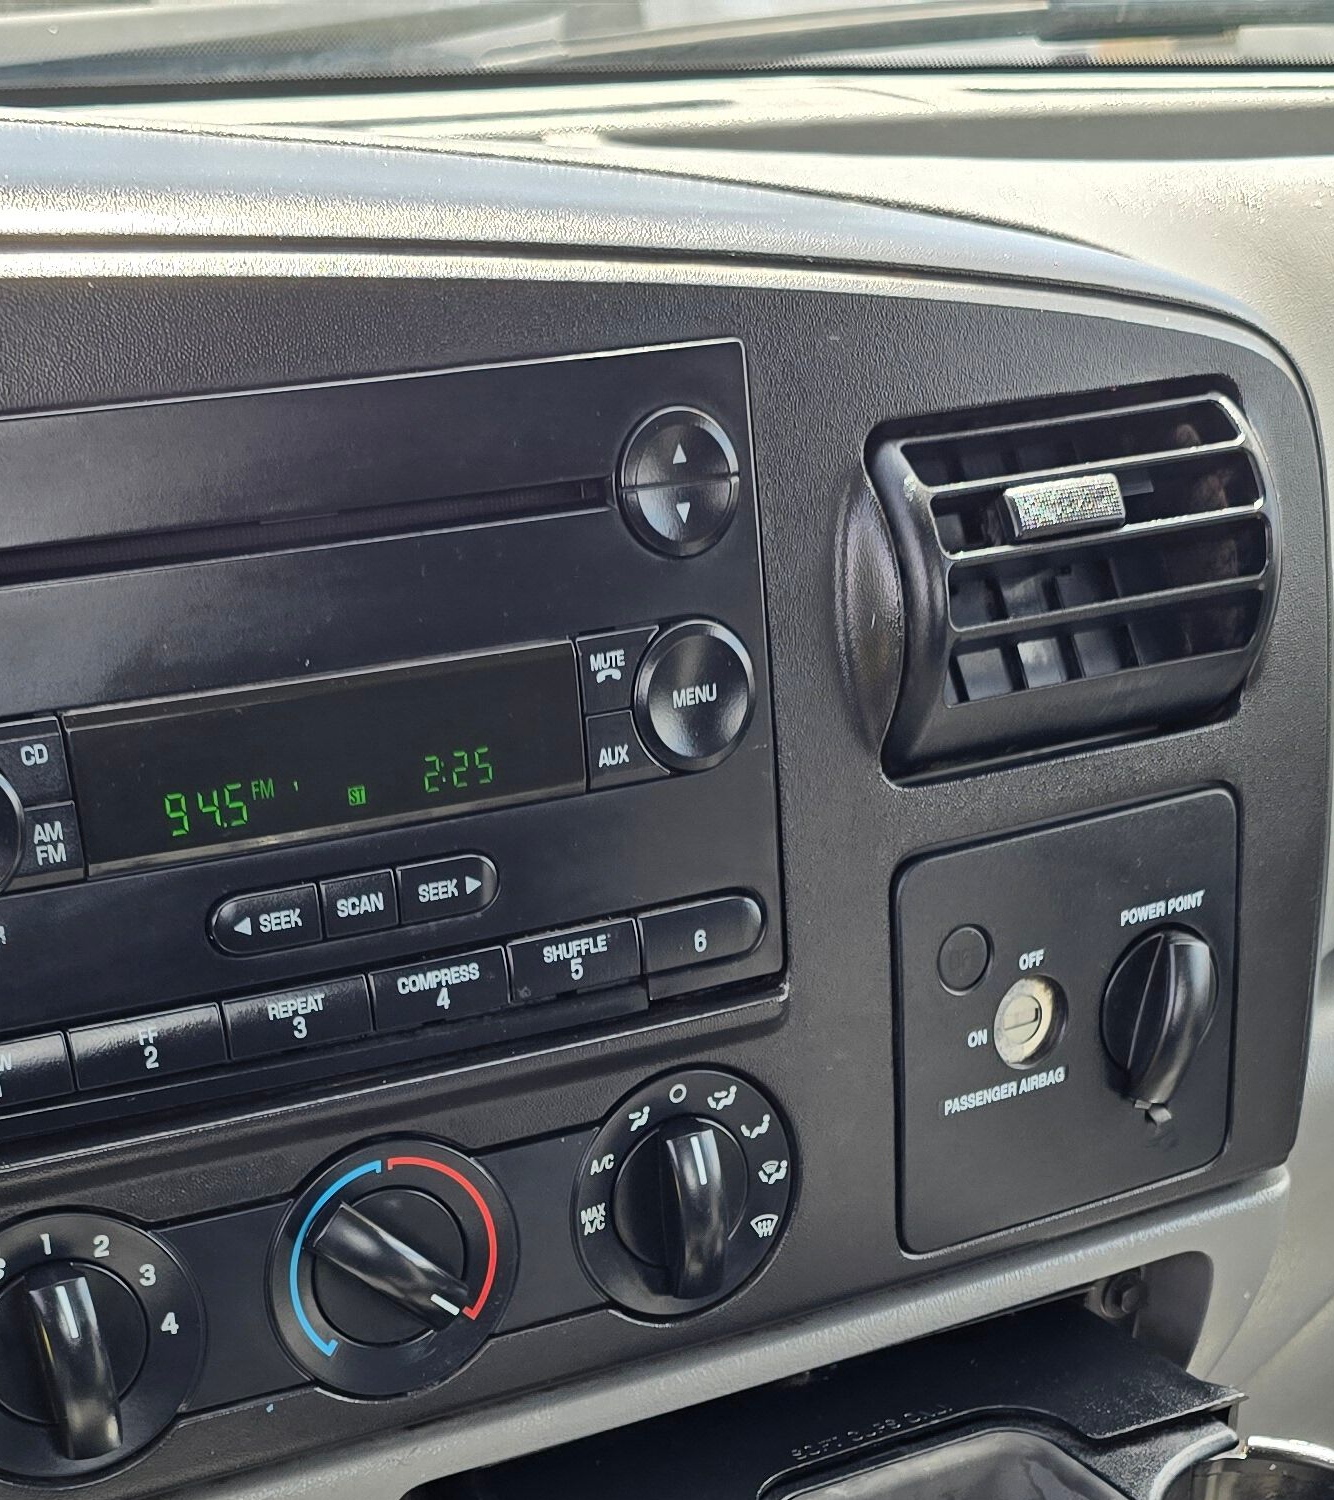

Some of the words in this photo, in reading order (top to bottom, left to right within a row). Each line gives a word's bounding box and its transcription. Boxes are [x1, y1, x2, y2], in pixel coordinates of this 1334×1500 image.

[590, 649, 626, 672] MUTE
[672, 682, 718, 709] MENU
[20, 744, 49, 766] CD
[598, 744, 630, 767] AUX
[423, 745, 494, 793] 2:25
[164, 783, 249, 836] 94.5
[252, 778, 275, 801] FM
[348, 785, 366, 806] ST
[34, 821, 63, 843] AM
[37, 843, 67, 866] FM
[417, 879, 459, 903] SEEK
[336, 892, 385, 919] SCAN
[1120, 901, 1166, 926] POWER
[1167, 890, 1206, 916] POINT
[259, 909, 302, 933] SEEK
[542, 933, 608, 965] SHUFFLE
[693, 929, 708, 953] 6
[570, 958, 585, 982] 5
[1018, 949, 1045, 971] OFF
[396, 962, 480, 994] COMPRESS
[267, 993, 325, 1021] REPEAT
[436, 987, 451, 1010] 4
[138, 1027, 158, 1046] FF
[292, 1016, 308, 1040] 3
[967, 1030, 988, 1048] ON
[144, 1046, 159, 1070] 2
[944, 1080, 1018, 1117] PASSENGER
[1018, 1067, 1065, 1096] AIRBAG
[590, 1153, 615, 1176] A/C
[580, 1202, 607, 1224] MAX
[583, 1215, 606, 1237] A/C
[40, 1233, 52, 1255] 1
[93, 1235, 111, 1258] 2
[139, 1264, 157, 1287] 3
[160, 1312, 179, 1335] 4
[791, 1436, 842, 1461] SOFT
